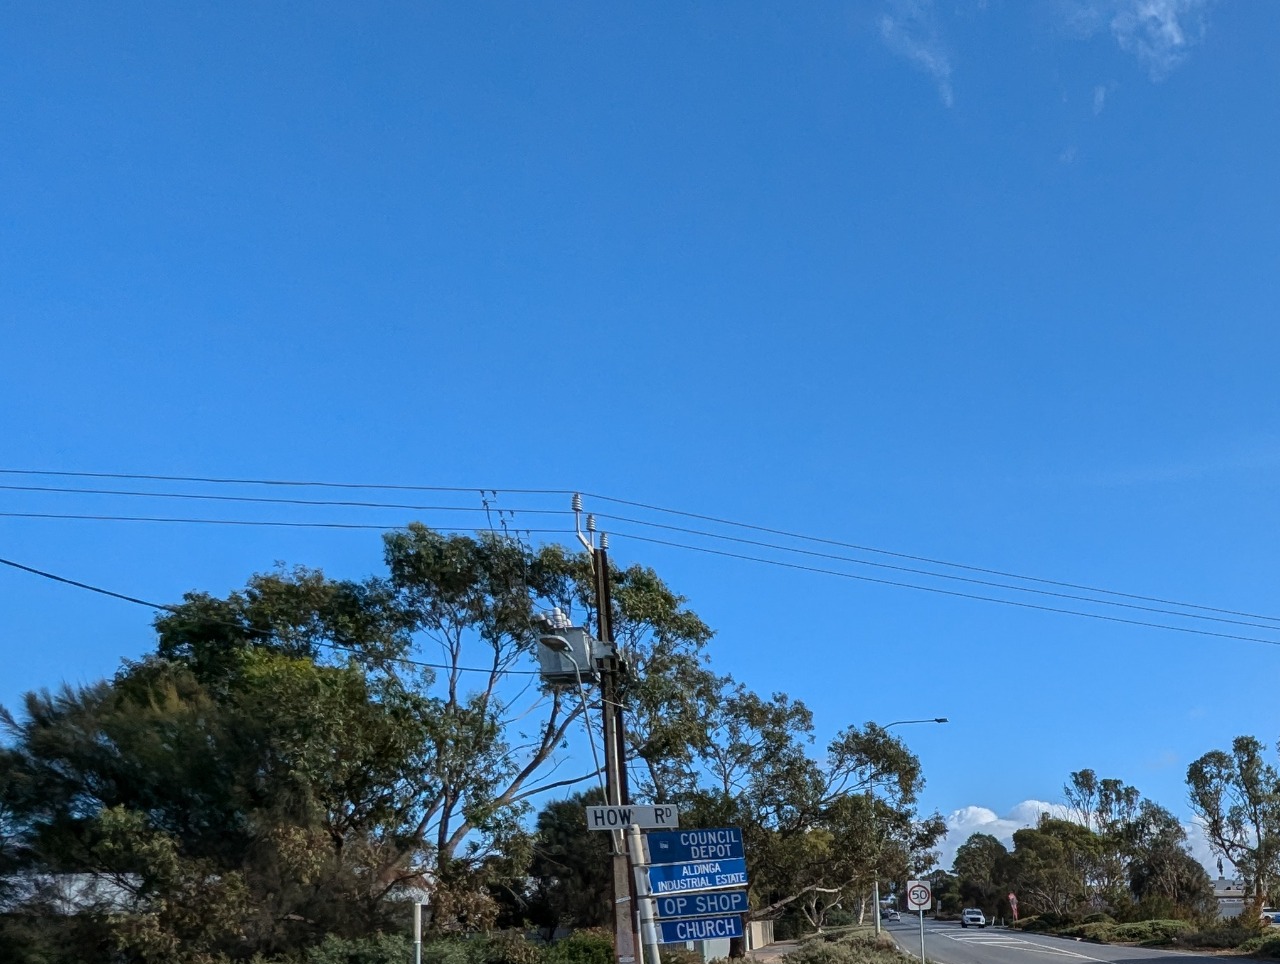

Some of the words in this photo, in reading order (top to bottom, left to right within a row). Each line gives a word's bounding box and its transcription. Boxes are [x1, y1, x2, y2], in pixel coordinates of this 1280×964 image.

[593, 808, 632, 826] HOW
[680, 830, 739, 846] COUNCIL
[691, 844, 732, 859] DEPOT
[682, 863, 722, 876] ALDINGA
[657, 876, 713, 892] INDUSTRIAL
[715, 872, 747, 886] ESTATE
[911, 889, 928, 900] 50
[664, 897, 687, 915] OP
[696, 894, 742, 913] SHOP
[676, 918, 736, 940] CHURCH
